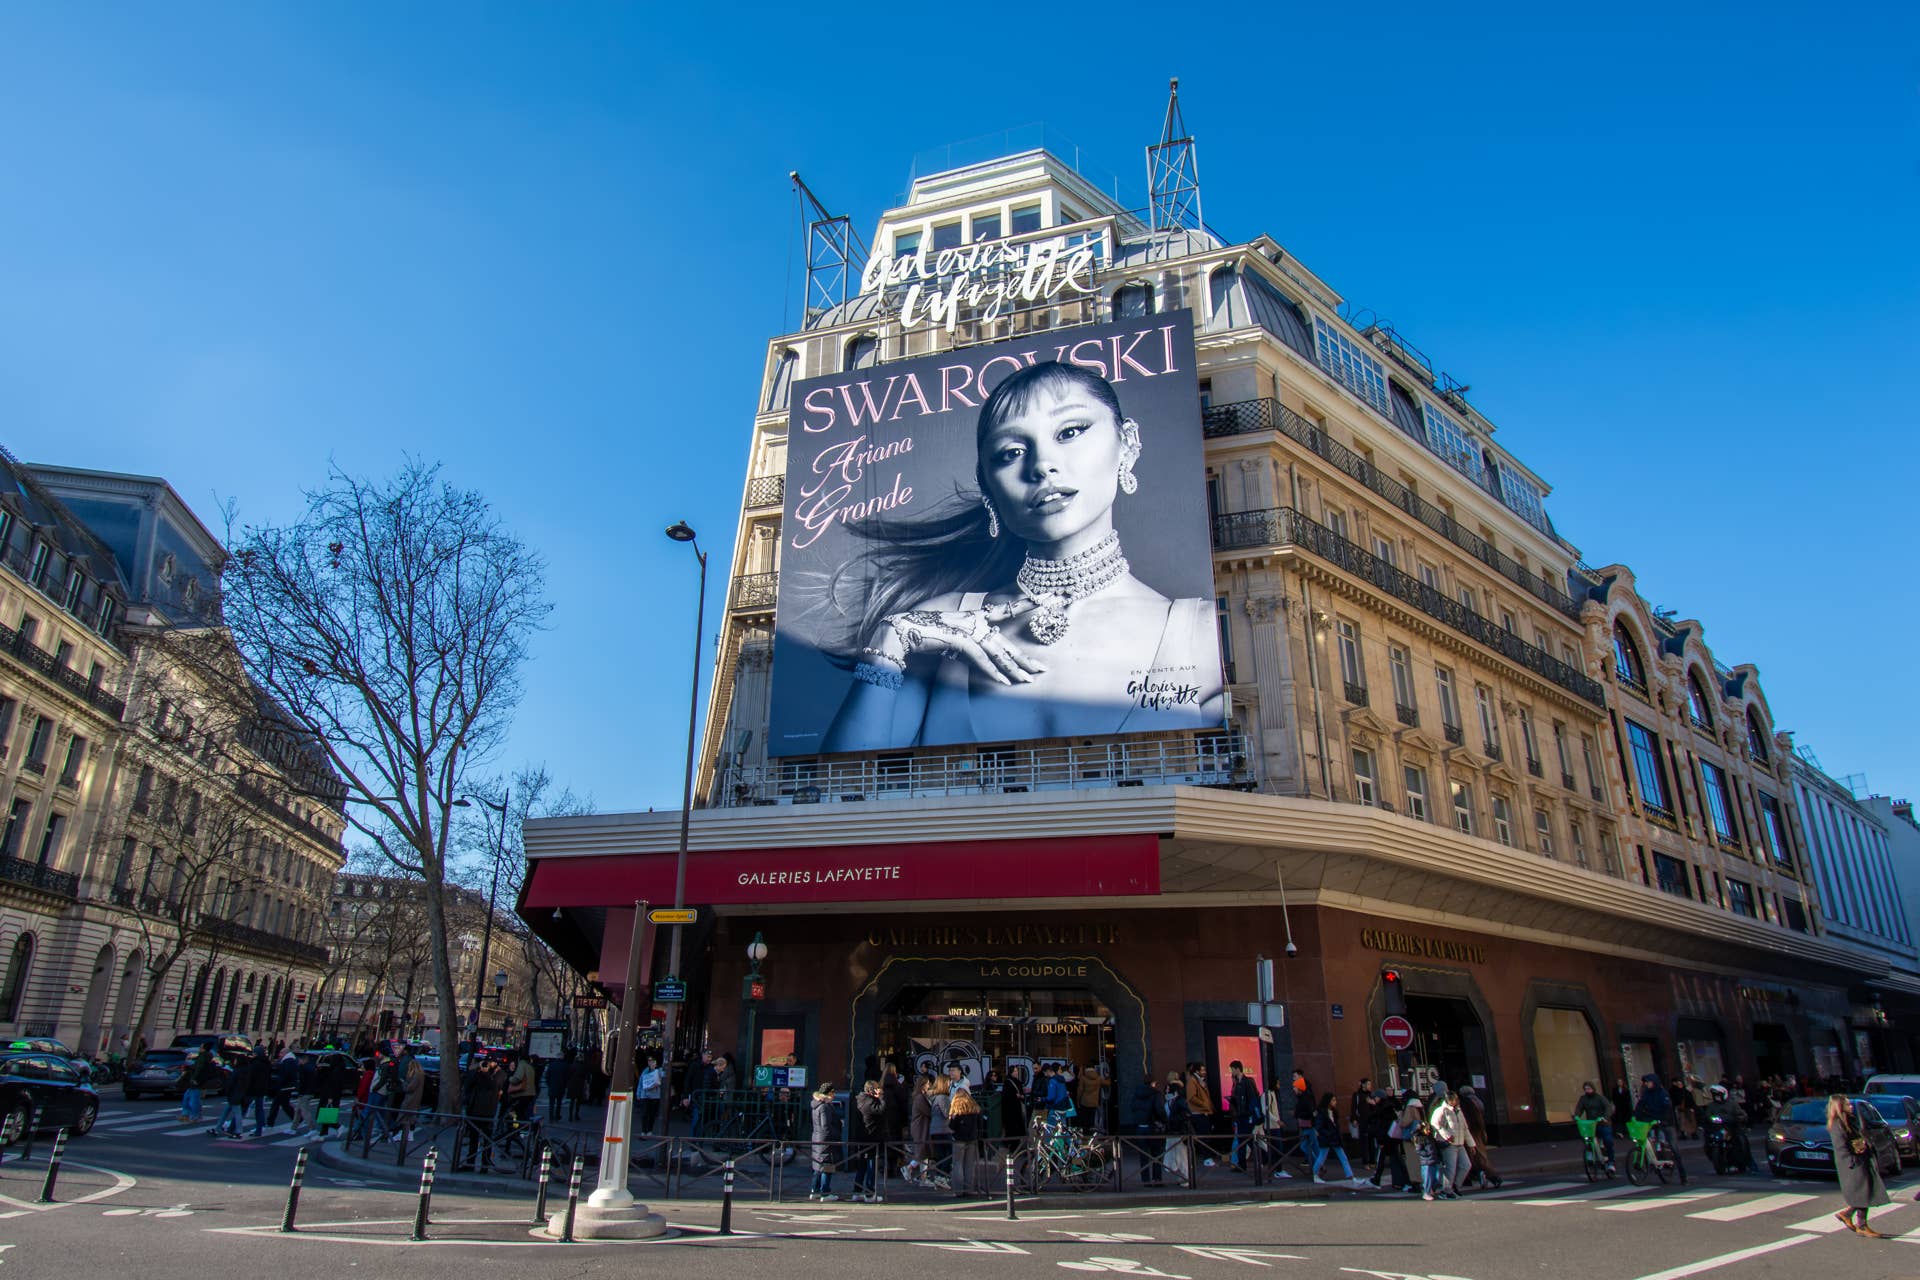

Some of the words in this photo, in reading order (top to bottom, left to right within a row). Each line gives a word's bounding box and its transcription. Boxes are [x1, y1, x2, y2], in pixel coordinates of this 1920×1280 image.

[900, 234, 1108, 332] Lafayette
[800, 433, 914, 498] Ariana
[792, 472, 914, 549] Grande
[1140, 684, 1202, 711] Lafayette
[737, 871, 811, 885] GALERIES
[815, 866, 901, 883] LAFAYETTE
[868, 927, 979, 946] GALERIES
[985, 924, 1121, 945] LAFAYETTE
[1362, 928, 1422, 954] GALERIES
[980, 966, 1001, 977] LA
[1007, 965, 1088, 977] COUPOLE
[1040, 1023, 1089, 1035] DUPONT
